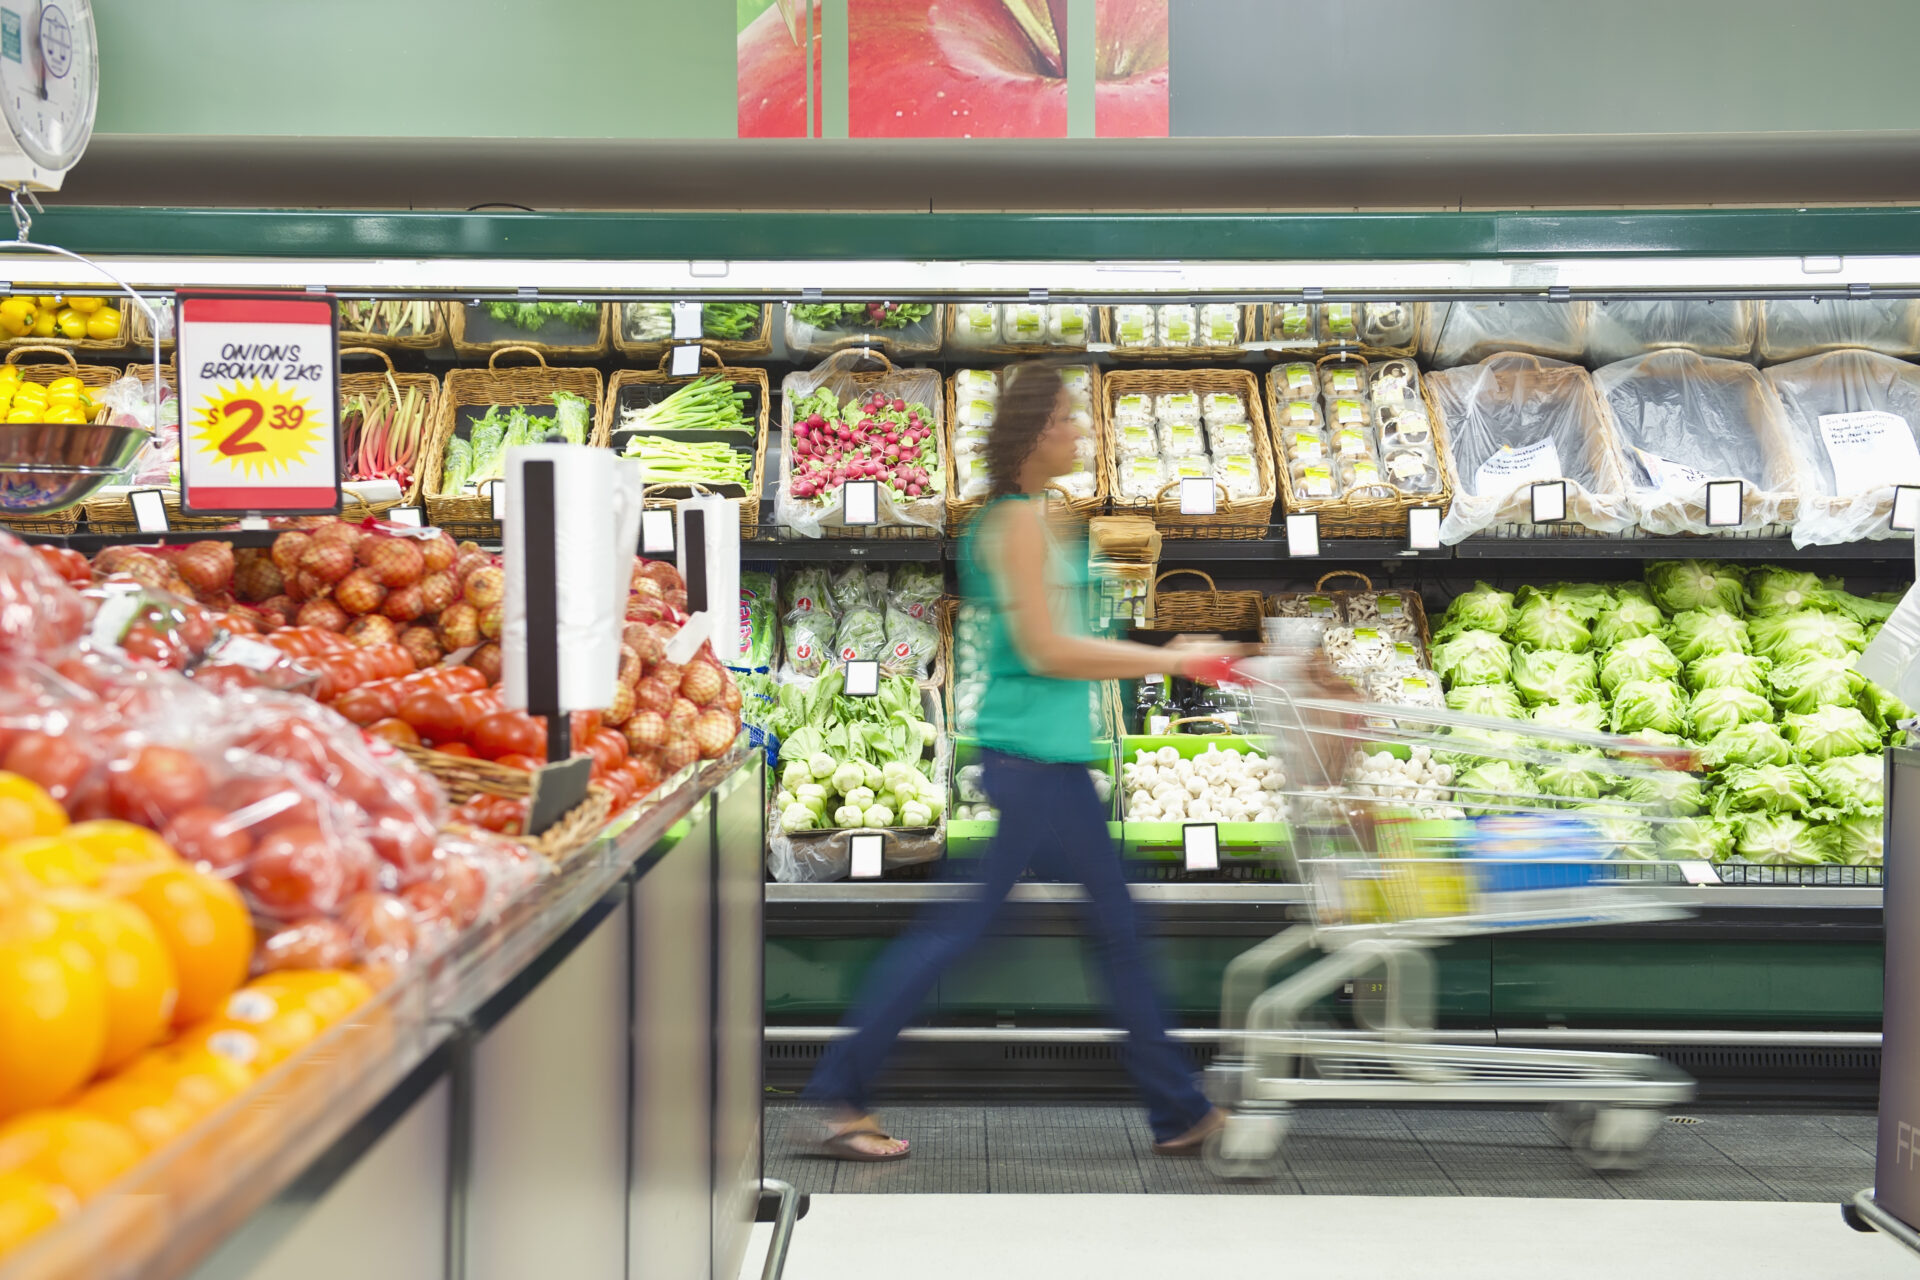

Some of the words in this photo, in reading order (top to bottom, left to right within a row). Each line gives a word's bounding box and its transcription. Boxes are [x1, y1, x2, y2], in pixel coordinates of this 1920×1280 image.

[221, 343, 301, 362] ONIONS
[200, 362, 280, 380] BROWN
[283, 364, 323, 381] 2KG
